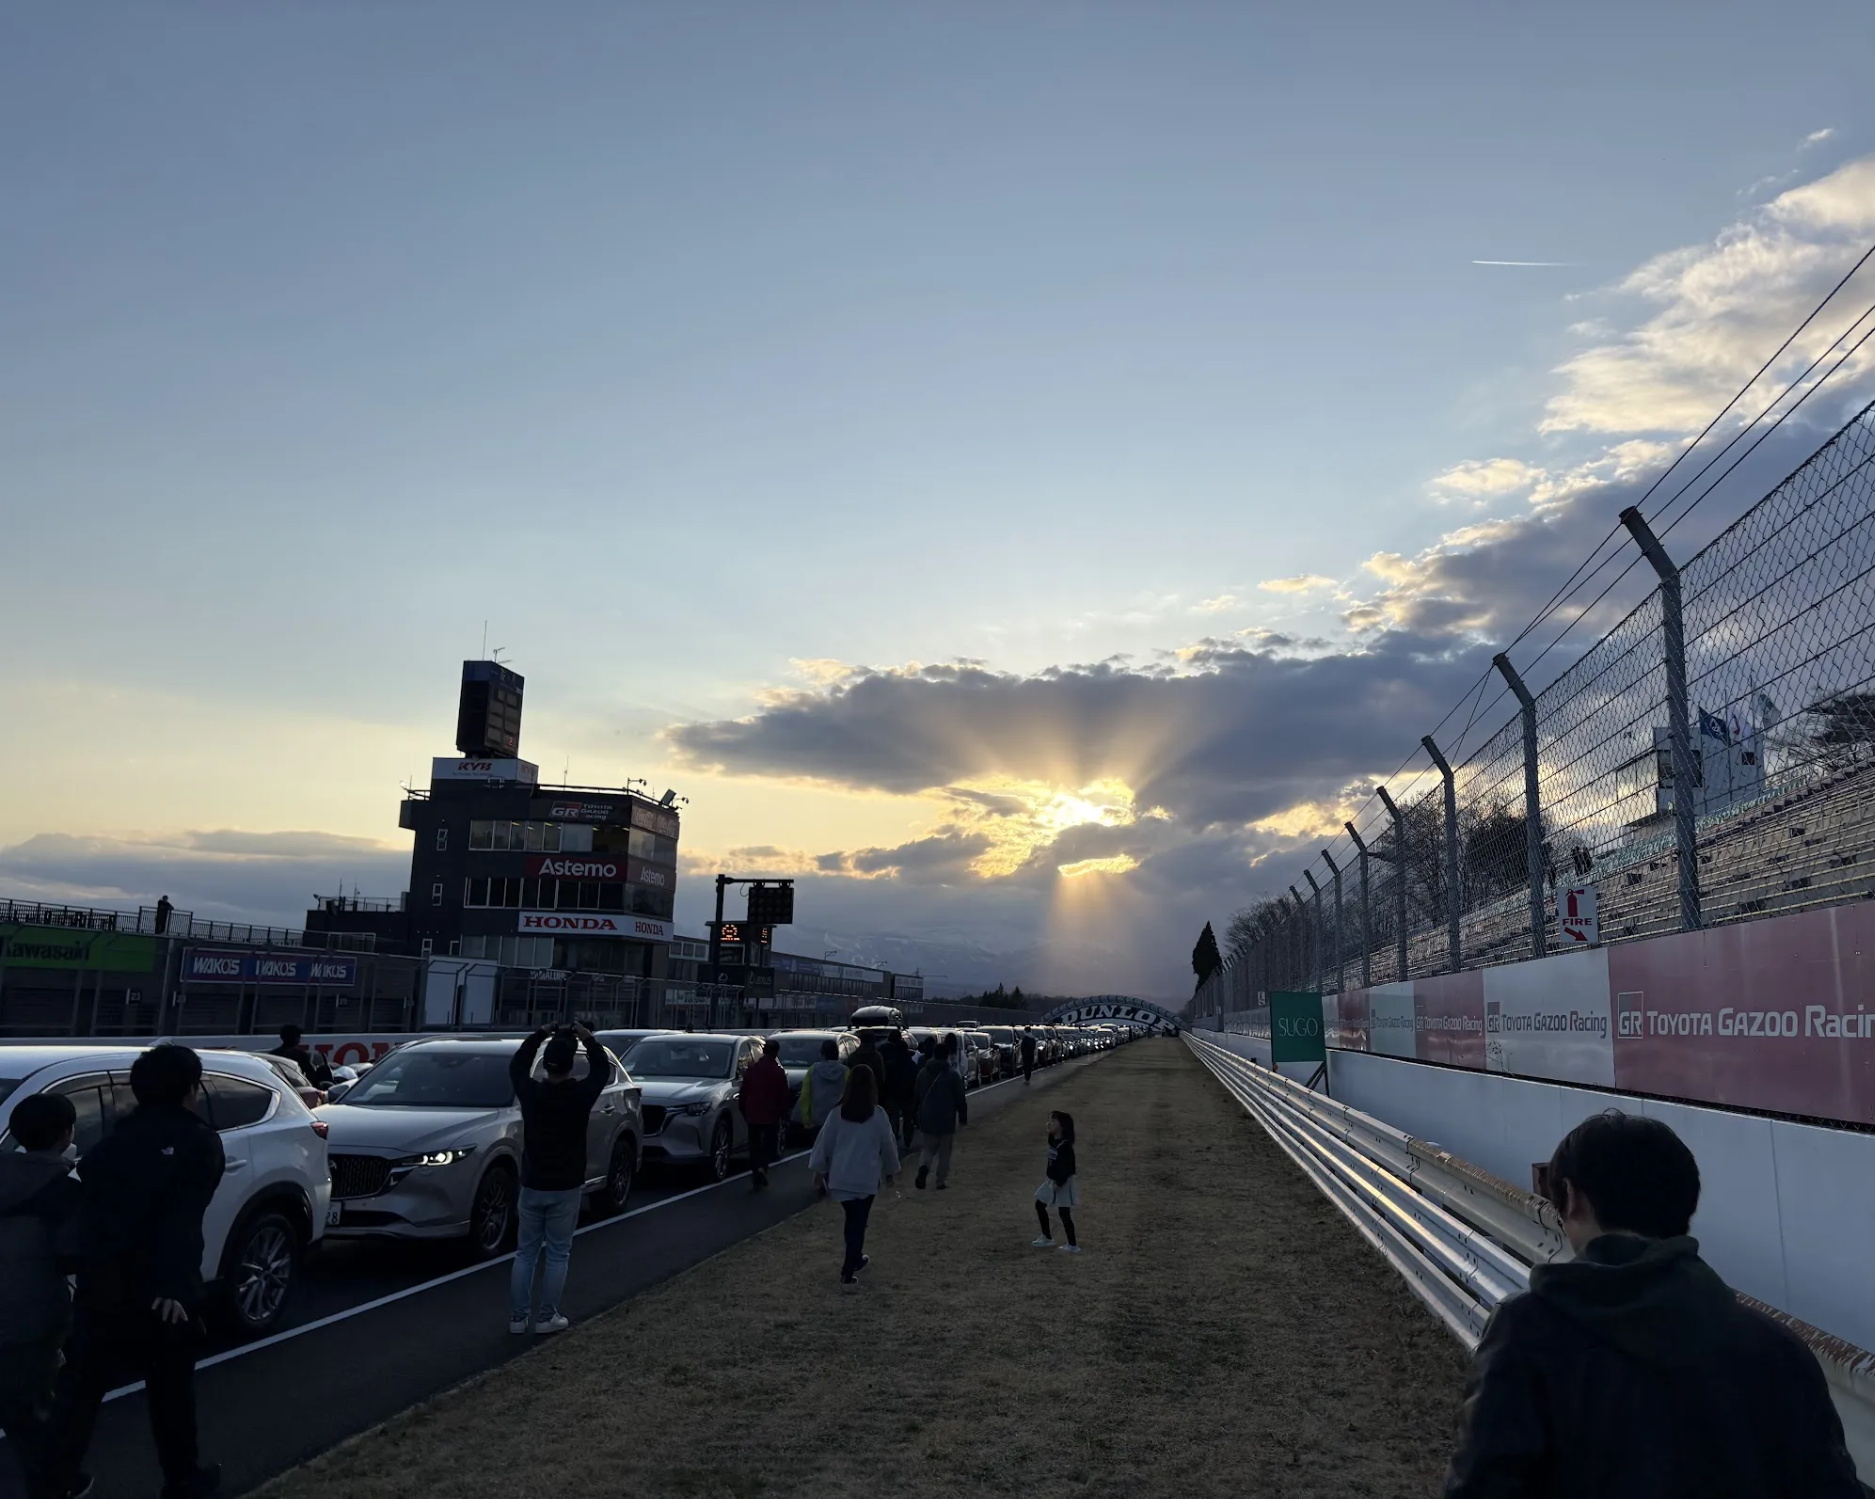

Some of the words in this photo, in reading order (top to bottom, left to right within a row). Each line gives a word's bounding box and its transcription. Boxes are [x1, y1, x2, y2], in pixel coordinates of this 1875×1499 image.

[458, 762, 492, 771] KYB
[550, 807, 579, 817] GR
[539, 858, 617, 878] Astemo
[641, 866, 665, 886] Astemo
[523, 916, 617, 930] HONDA
[634, 921, 664, 936] HONDA
[1562, 918, 1592, 926] FIRE
[1060, 1004, 1176, 1031] DUNLOP
[1278, 1017, 1319, 1037] SUGO
[1462, 1015, 1482, 1036] Racing
[1487, 1014, 1500, 1031] GR
[1501, 1014, 1532, 1031] TOYOTA
[1533, 1012, 1567, 1031] GAZOO
[1569, 1010, 1607, 1039] Racing
[1619, 1011, 1642, 1035] GR
[1647, 1010, 1713, 1036] TOYOTA
[1717, 1007, 1798, 1037] GAZOO
